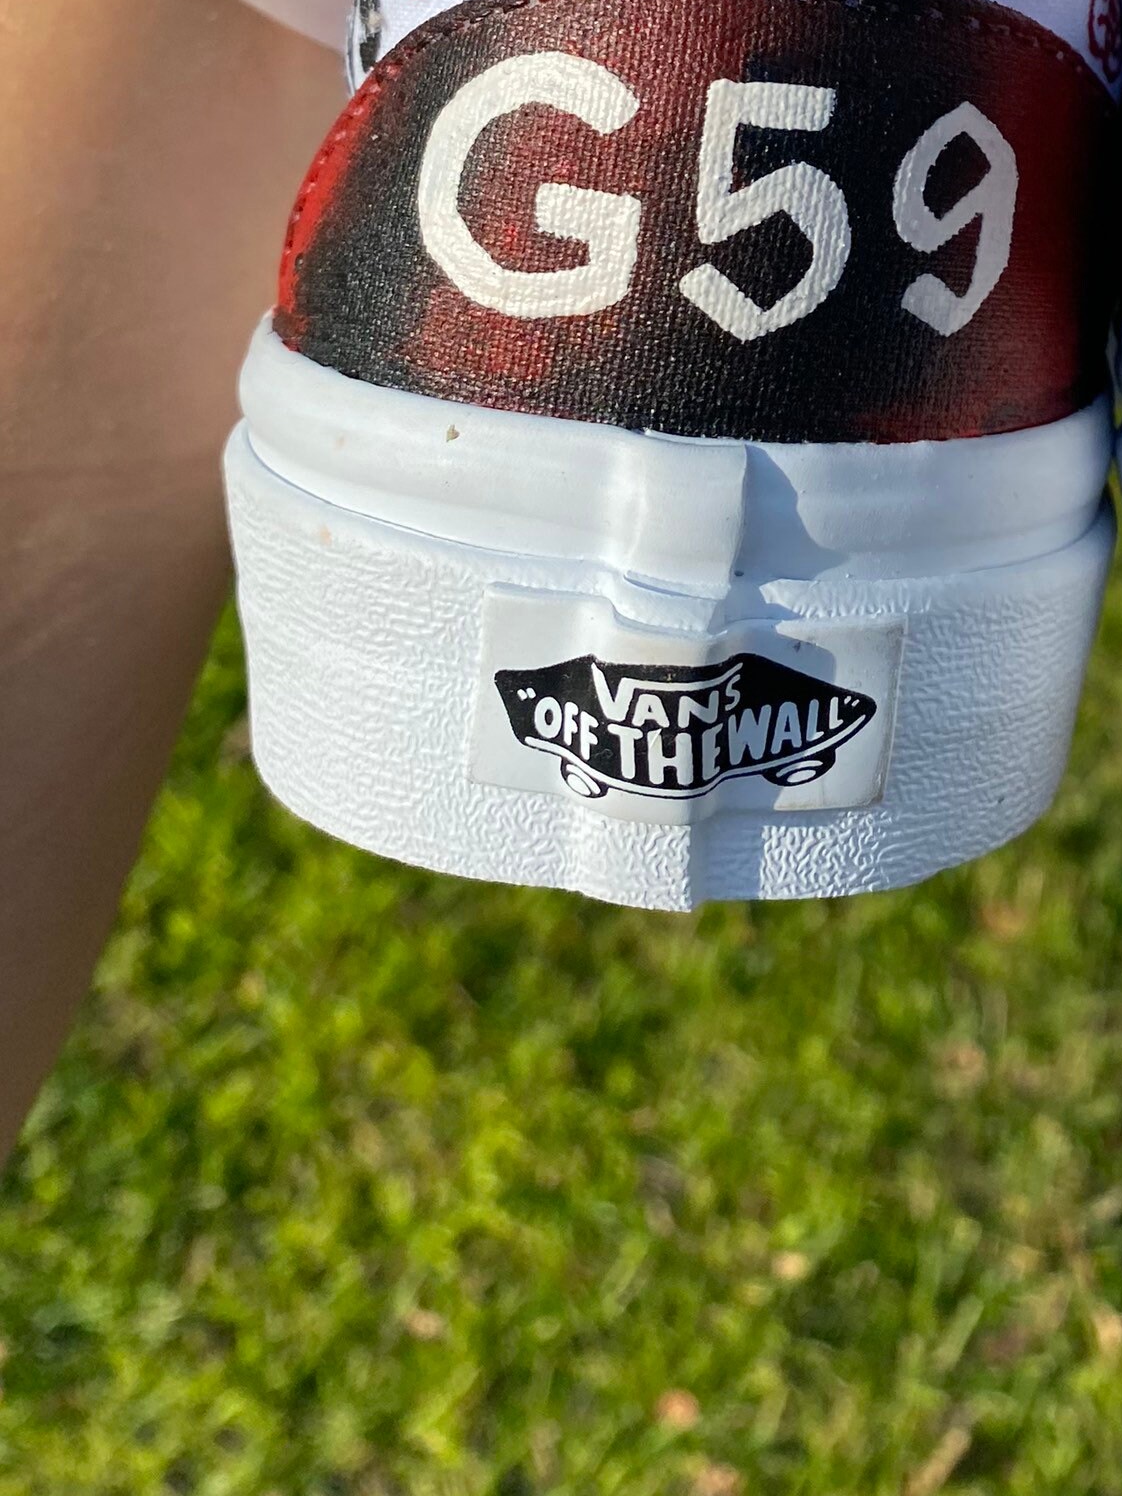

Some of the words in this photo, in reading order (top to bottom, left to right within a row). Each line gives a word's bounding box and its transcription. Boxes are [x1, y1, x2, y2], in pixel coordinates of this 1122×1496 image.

[418, 50, 1019, 343] G59
[591, 662, 744, 729] VANS
[607, 714, 721, 786] THE
